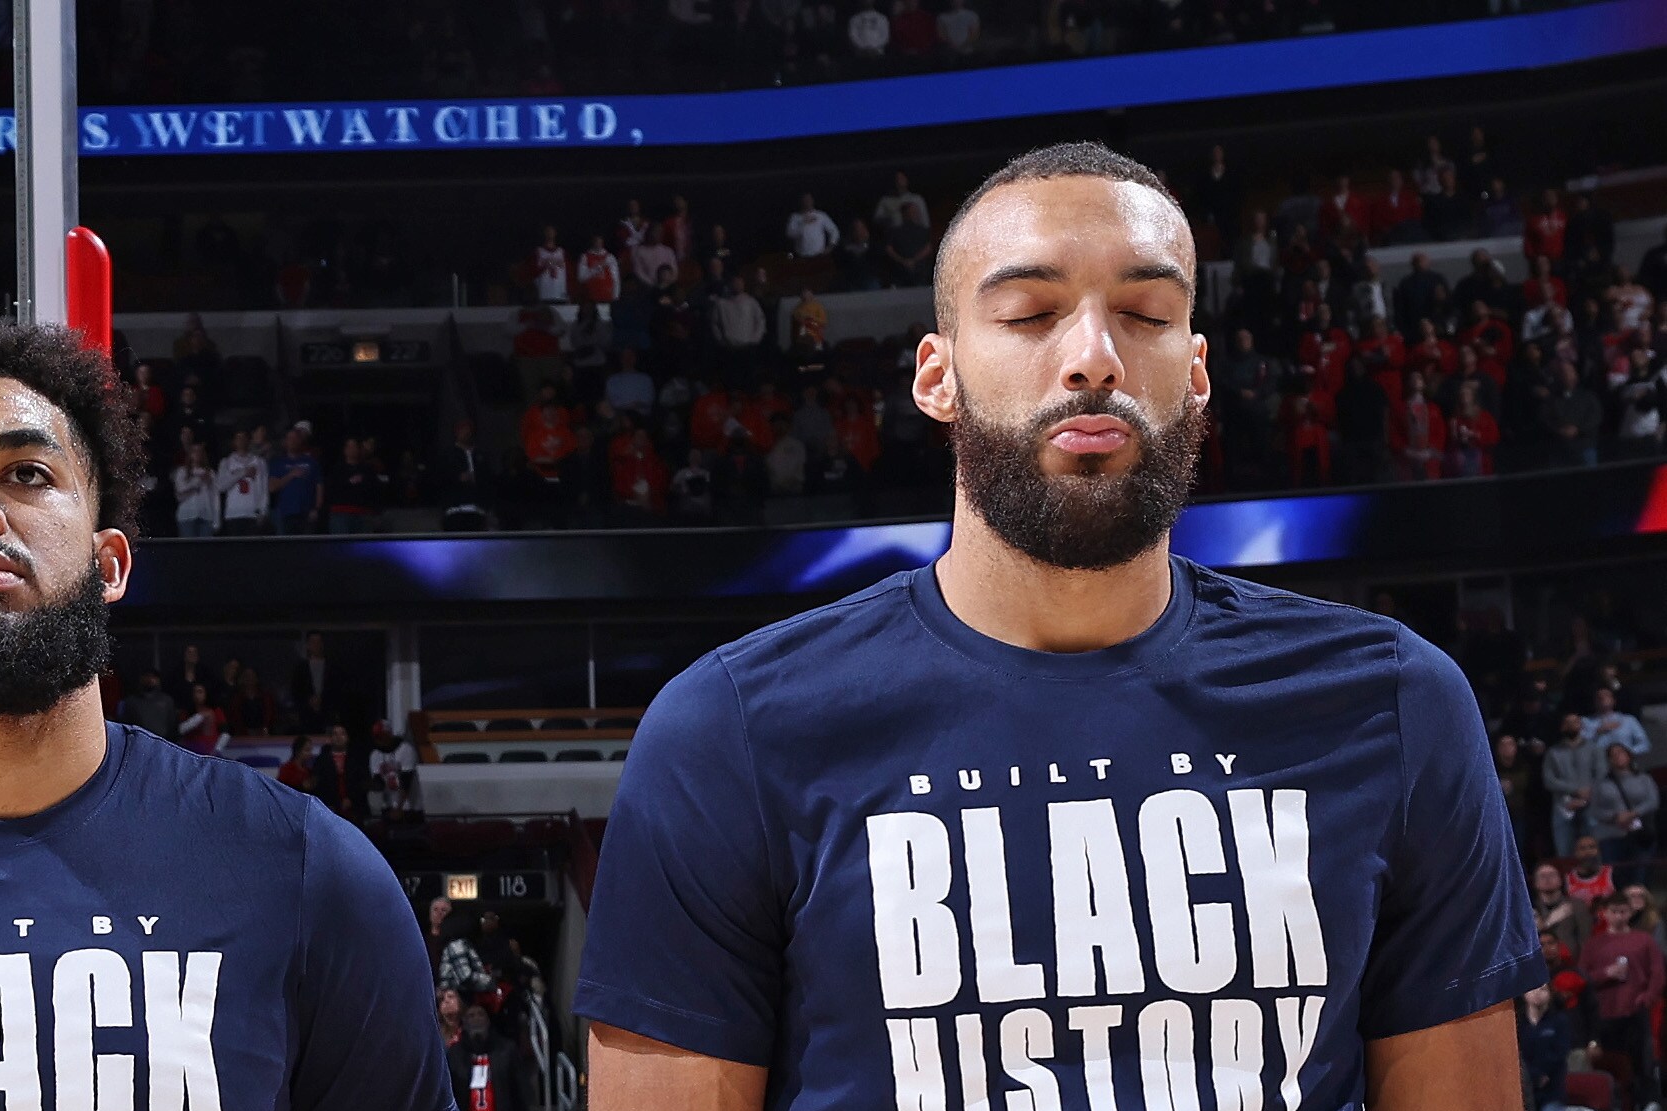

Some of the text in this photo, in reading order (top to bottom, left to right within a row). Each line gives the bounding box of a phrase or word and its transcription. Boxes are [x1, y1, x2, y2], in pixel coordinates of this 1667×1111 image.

[909, 753, 1237, 795] BUILT BY
[499, 875, 527, 897] 118
[866, 788, 1328, 1010] BLACK
[92, 915, 160, 935] BY
